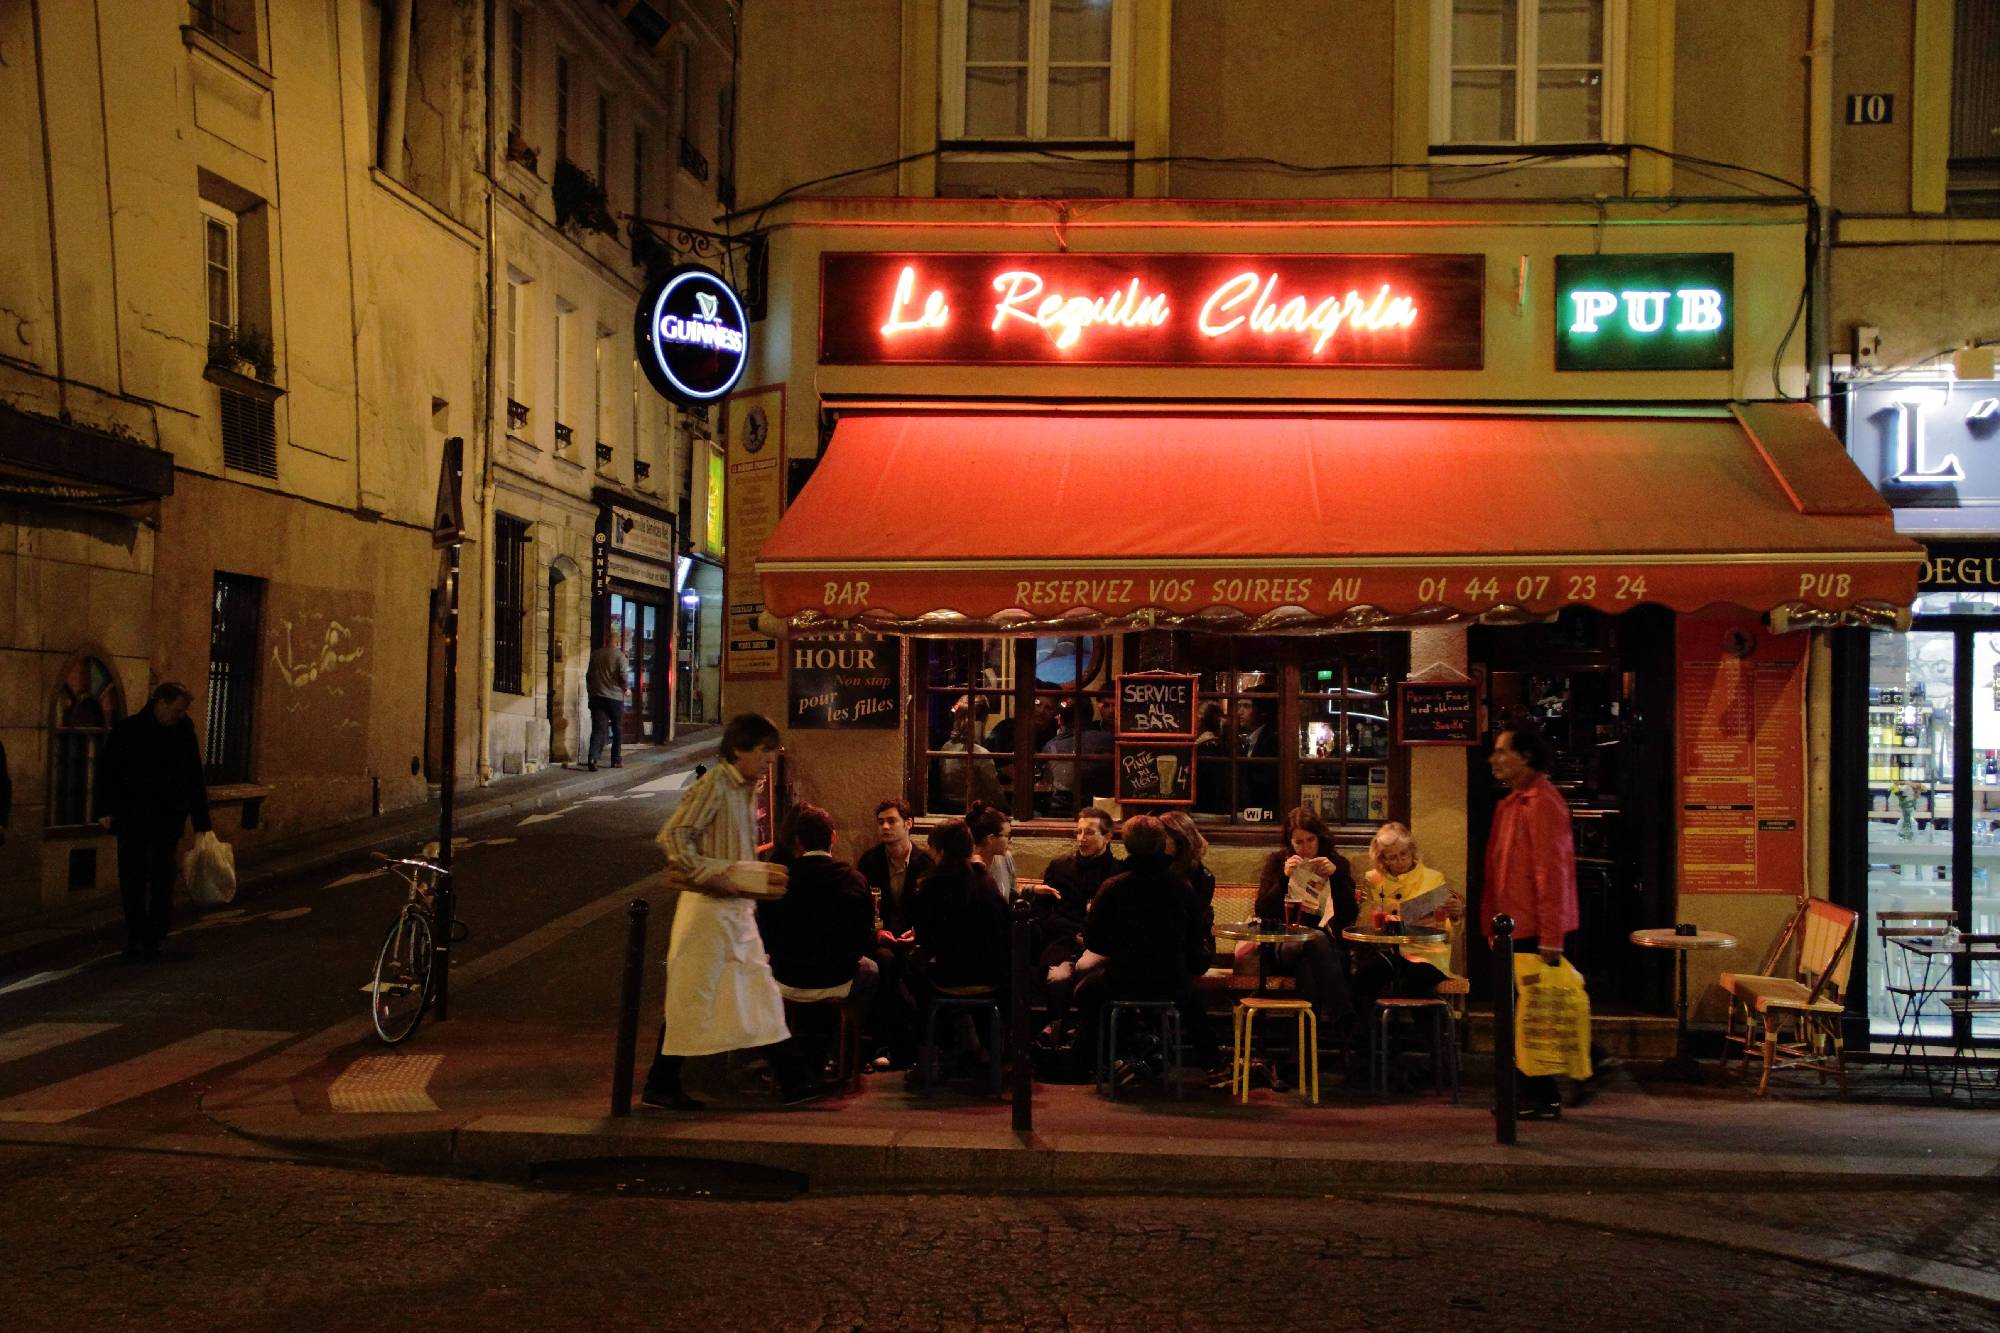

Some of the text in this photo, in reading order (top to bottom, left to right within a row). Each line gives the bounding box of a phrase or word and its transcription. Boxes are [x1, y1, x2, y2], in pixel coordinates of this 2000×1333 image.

[1854, 95, 1885, 122] 10
[880, 265, 950, 335] Le
[1199, 271, 1418, 354] Chagrin
[1569, 289, 1723, 332] PUB
[660, 315, 743, 353] GUINNESS
[823, 581, 870, 606] BAR
[1015, 575, 1647, 605] RESERVEZ VOS SOIREES AU 01 44 07 23 24
[1800, 573, 1852, 598] PUB
[794, 648, 876, 670] HOUR
[798, 692, 838, 715] pour
[1123, 684, 1186, 704] SERVICE
[826, 698, 894, 722] les filles
[1134, 713, 1180, 731] BAR
[1149, 703, 1165, 716] AU
